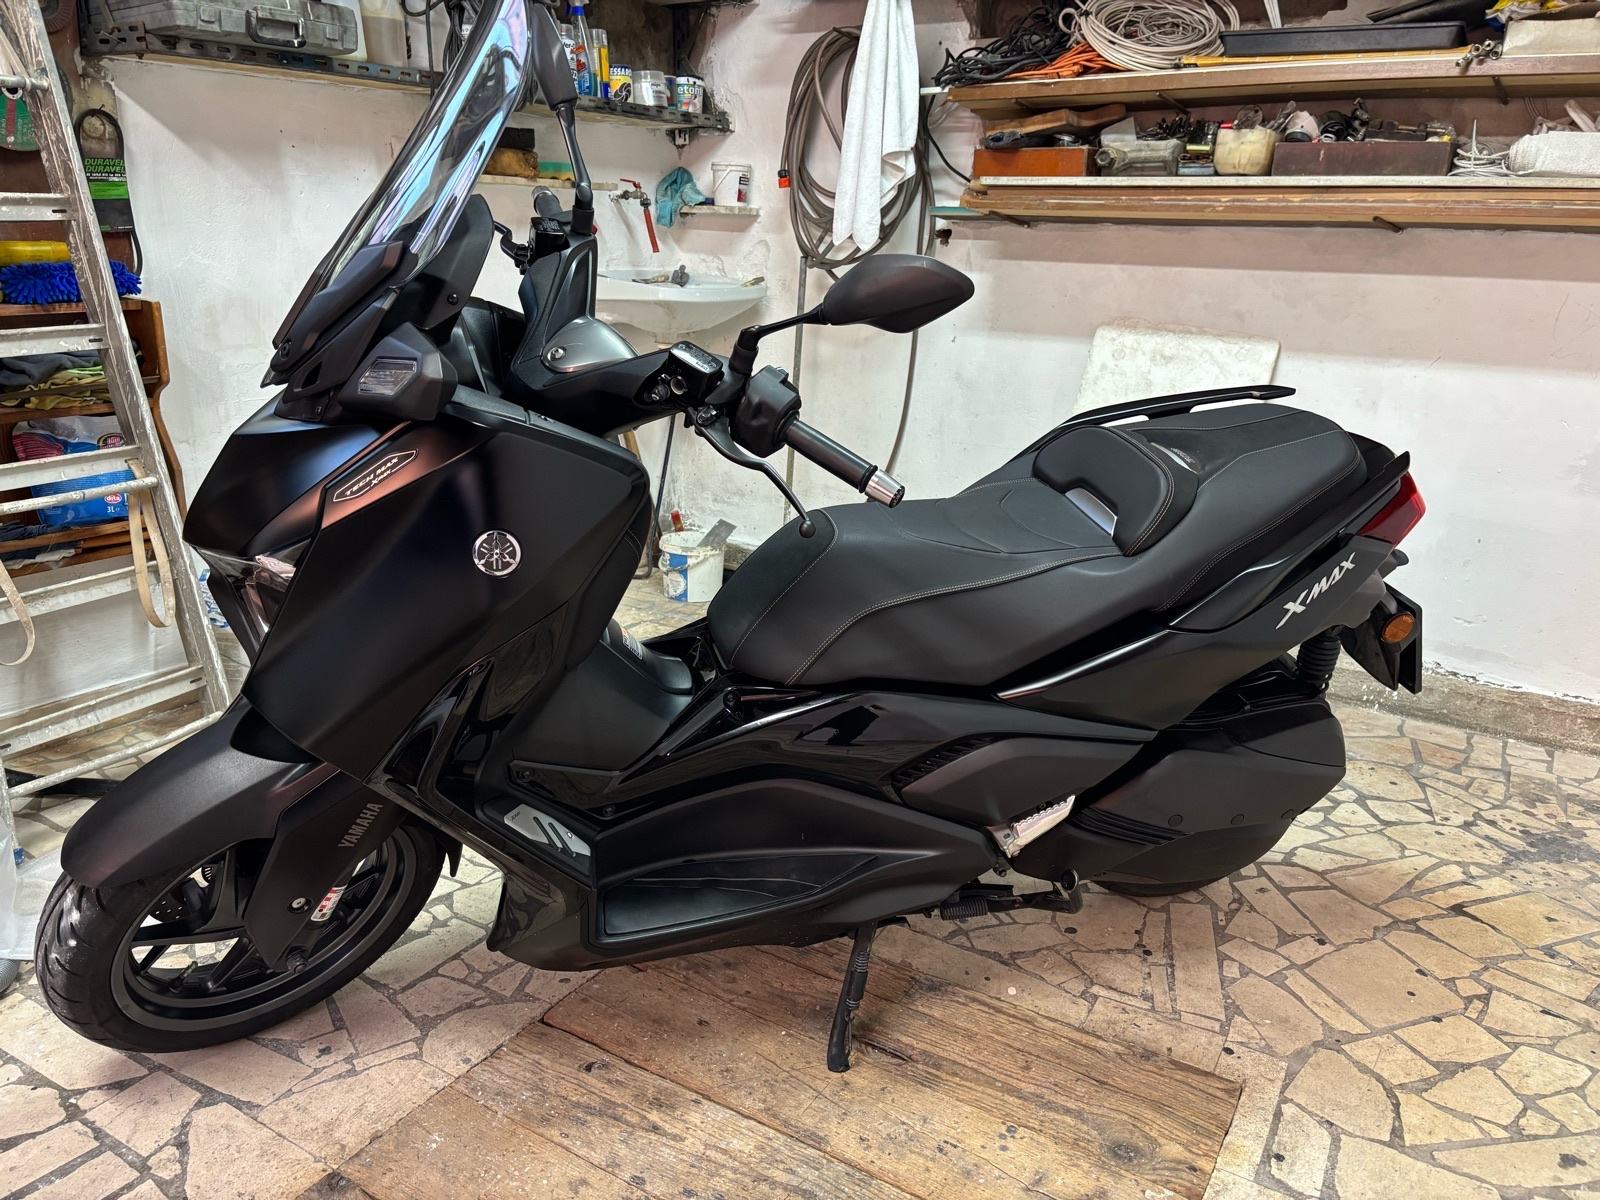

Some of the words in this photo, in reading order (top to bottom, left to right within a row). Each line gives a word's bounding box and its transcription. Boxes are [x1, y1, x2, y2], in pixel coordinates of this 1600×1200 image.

[345, 473, 374, 496] TECH
[376, 457, 399, 475] MAX
[1275, 551, 1356, 630] XMAX
[338, 802, 384, 848] YAMAHA
